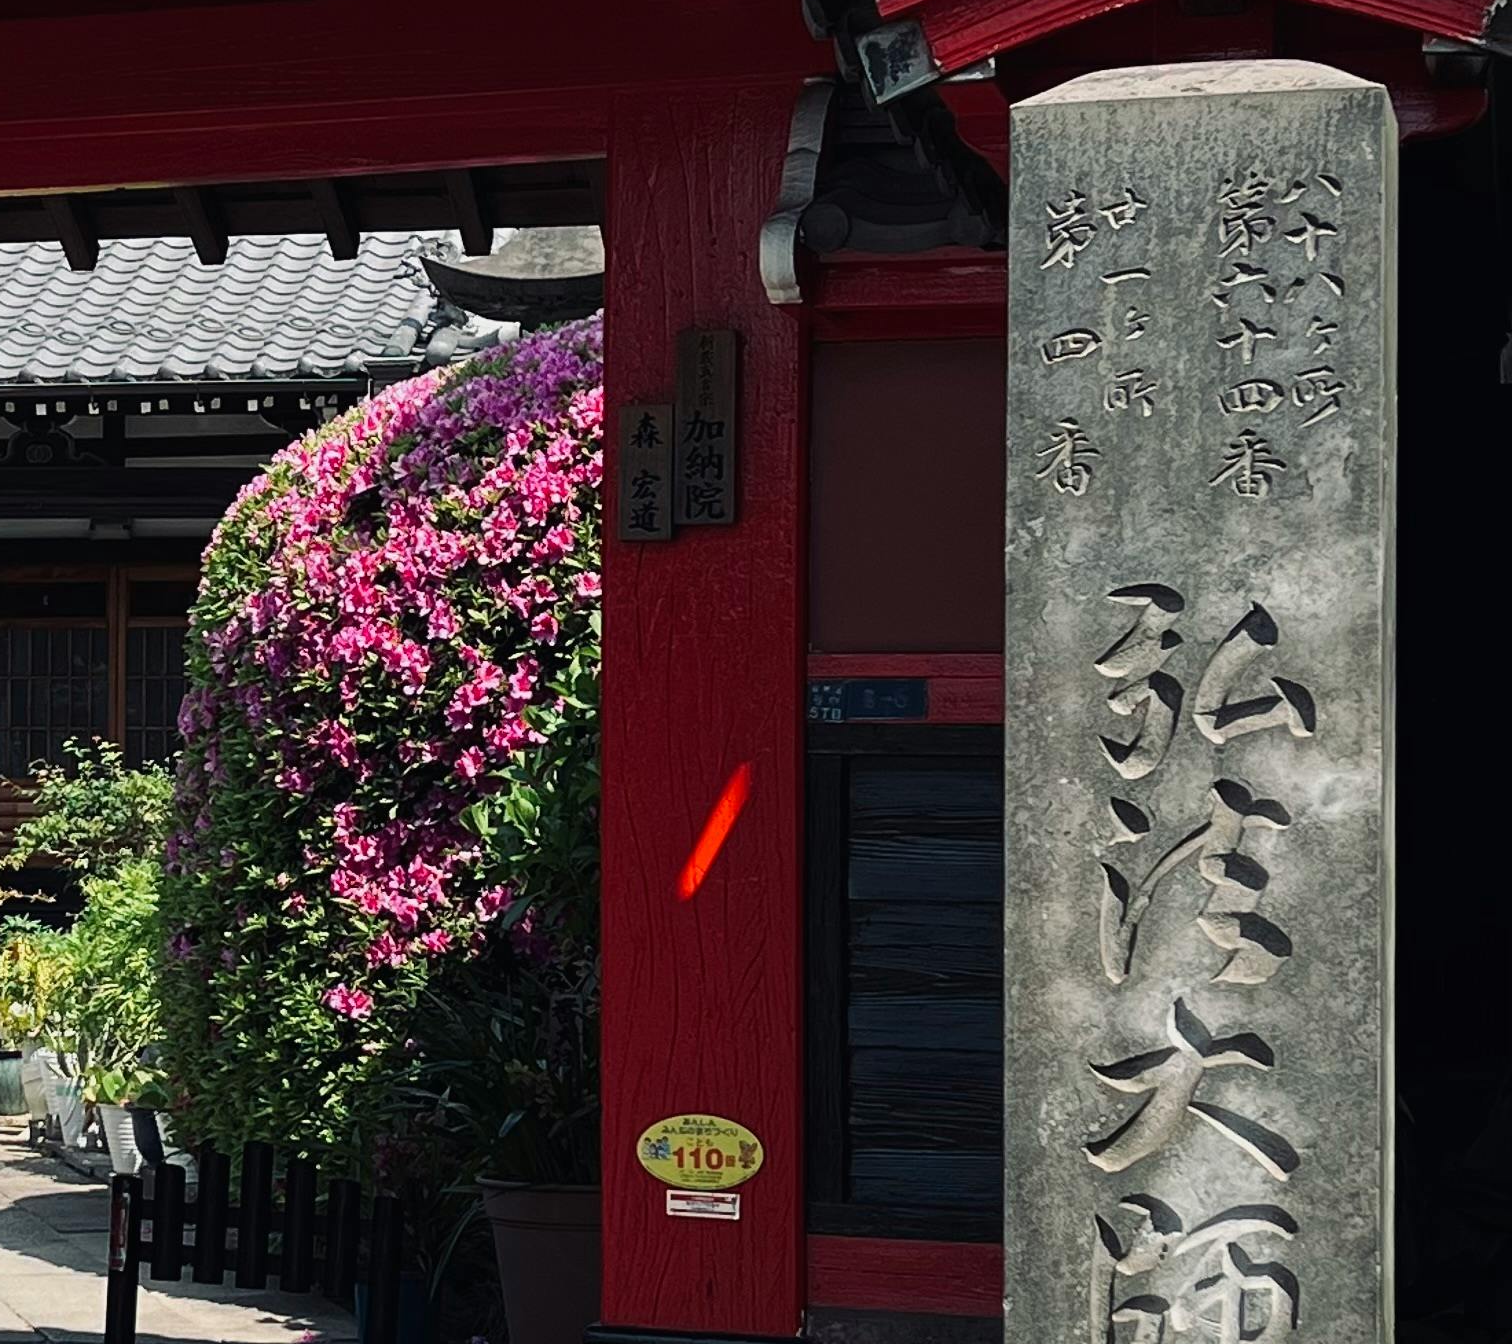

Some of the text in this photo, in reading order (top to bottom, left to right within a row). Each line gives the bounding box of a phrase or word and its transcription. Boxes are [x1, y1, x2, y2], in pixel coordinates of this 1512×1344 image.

[1209, 170, 1287, 498] 第六十四番
[628, 411, 664, 533] 森 宏道
[682, 410, 726, 520] 加納院
